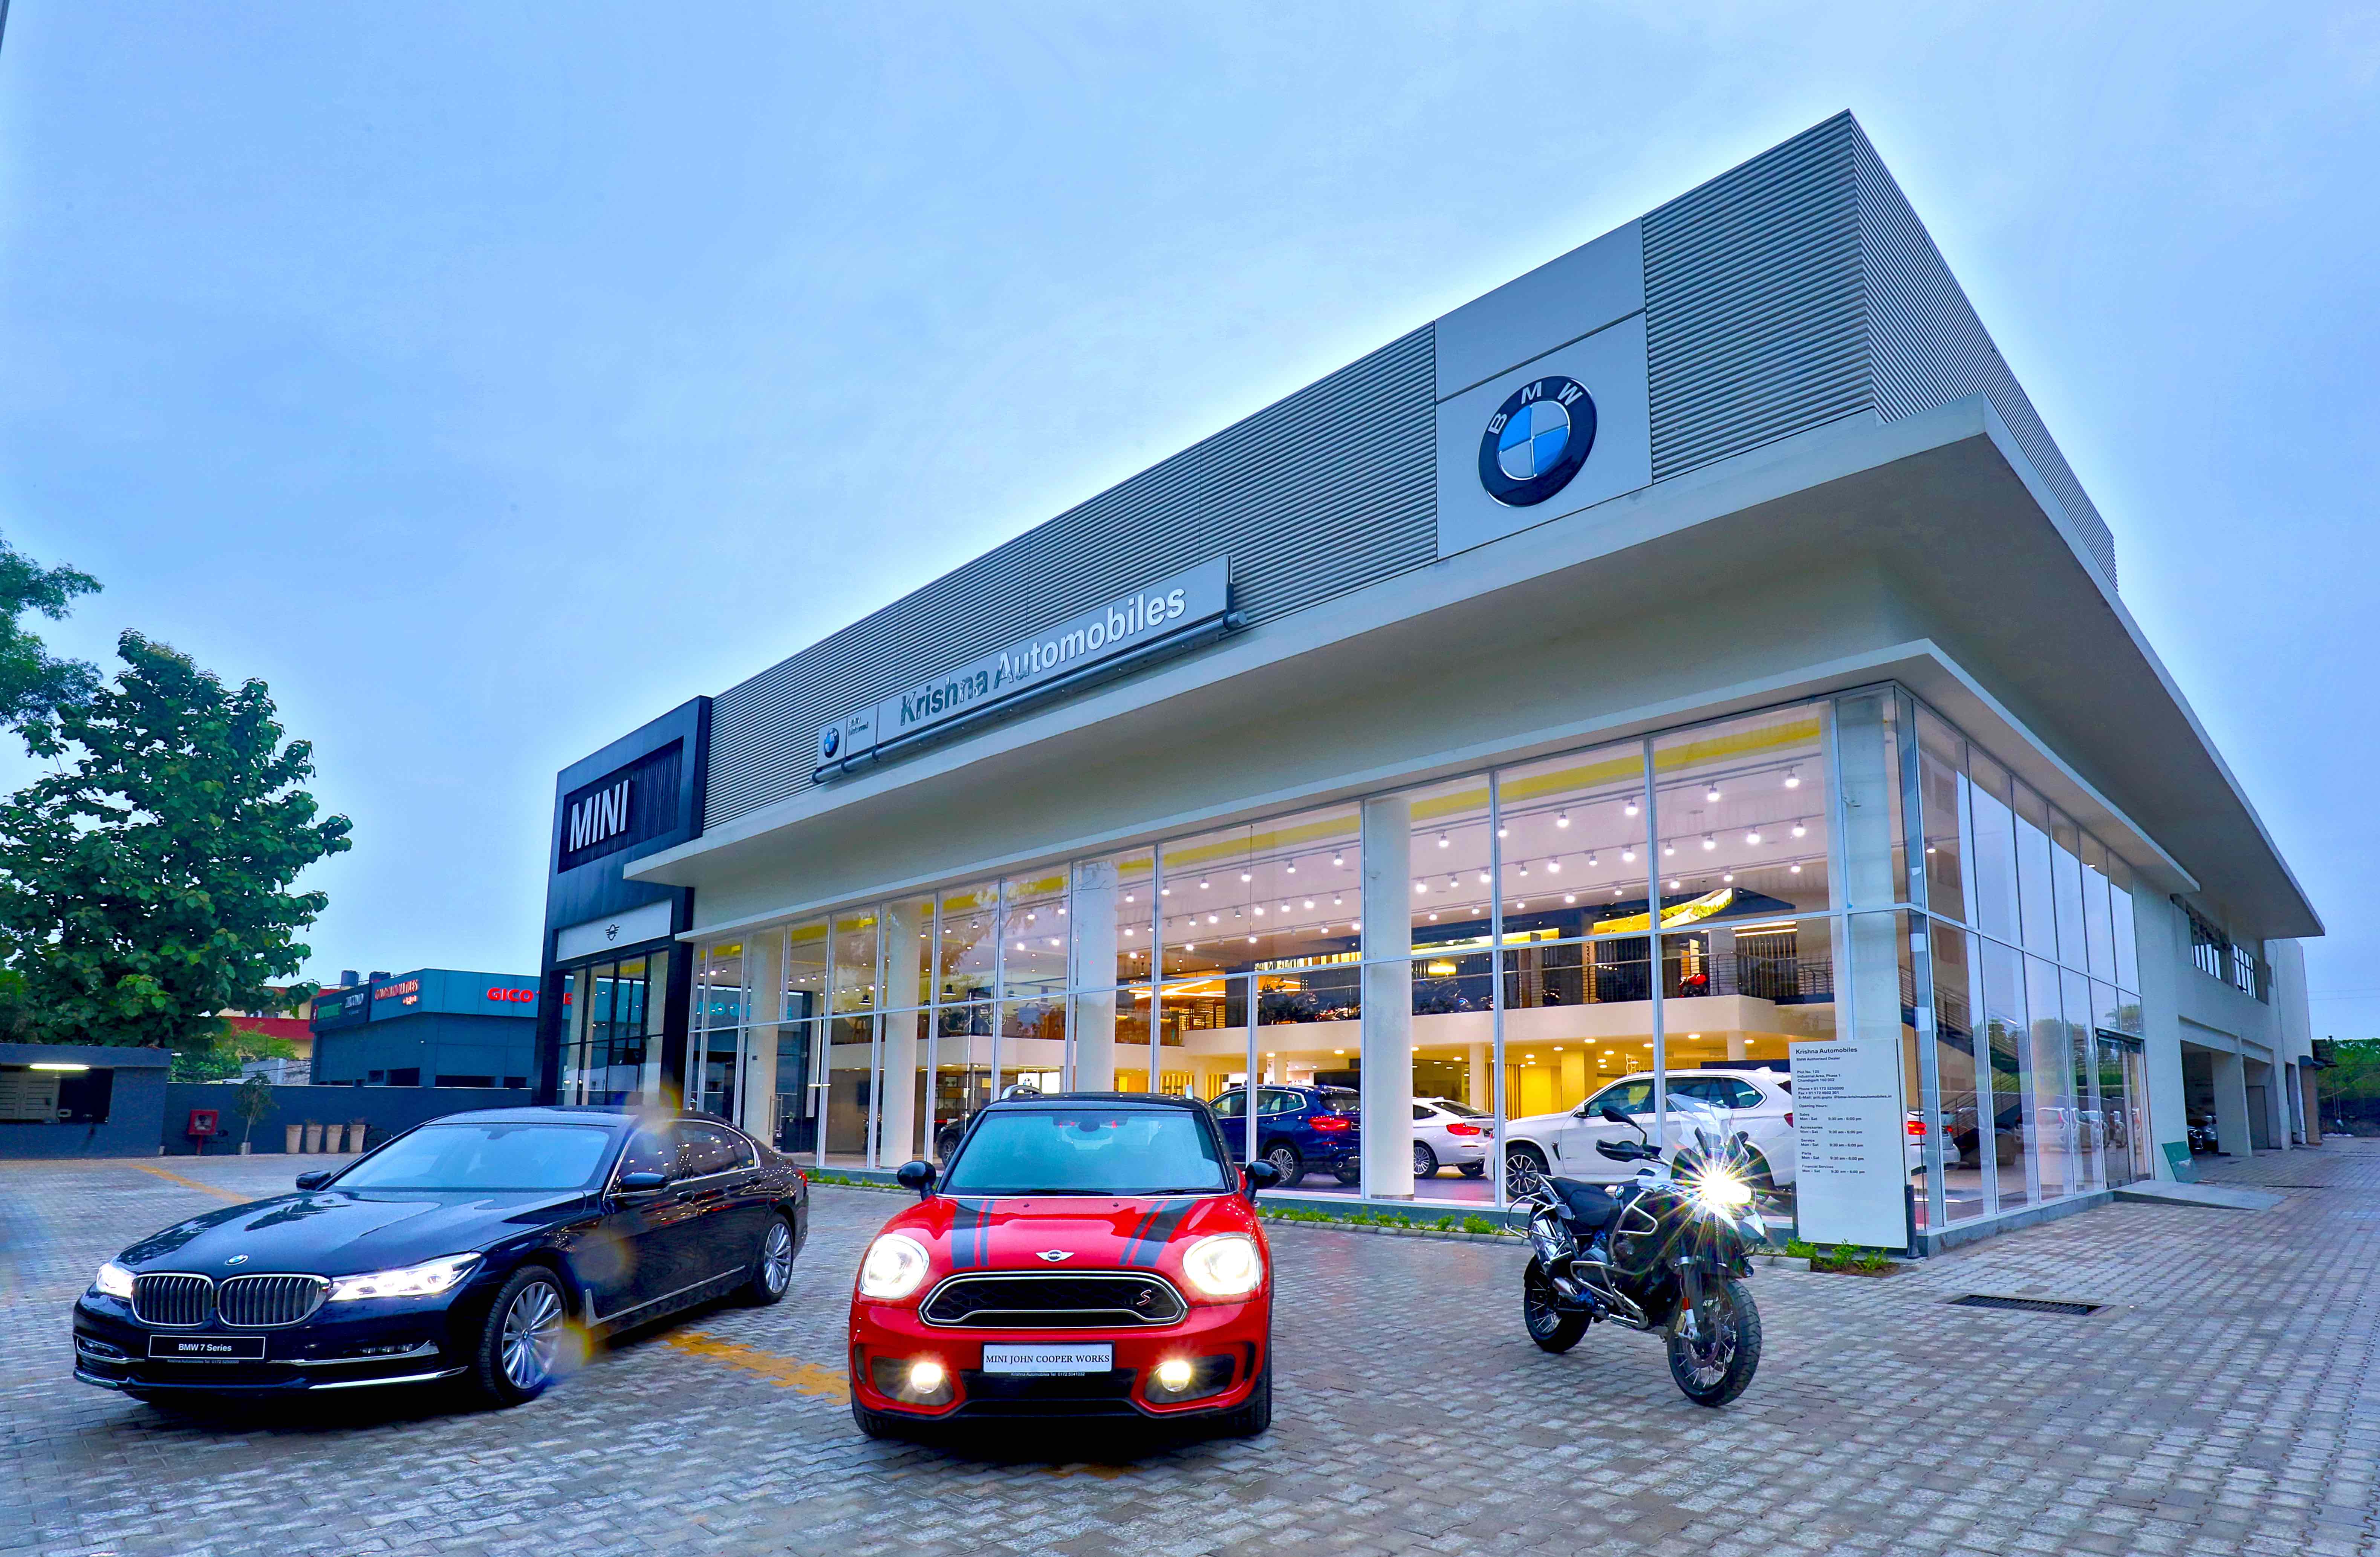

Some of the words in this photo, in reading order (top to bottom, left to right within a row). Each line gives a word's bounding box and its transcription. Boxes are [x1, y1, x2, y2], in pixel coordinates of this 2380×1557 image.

[1488, 381, 1583, 435] BMW
[900, 666, 988, 726] Krishna
[993, 587, 1186, 689] Automobiles
[569, 779, 629, 852] MINI
[487, 987, 534, 1003] GICO
[1136, 1289, 1152, 1306] S
[1009, 1355, 1034, 1365] JOHN
[1036, 1355, 1074, 1363] COOPER
[1075, 1354, 1110, 1363] WORKS
